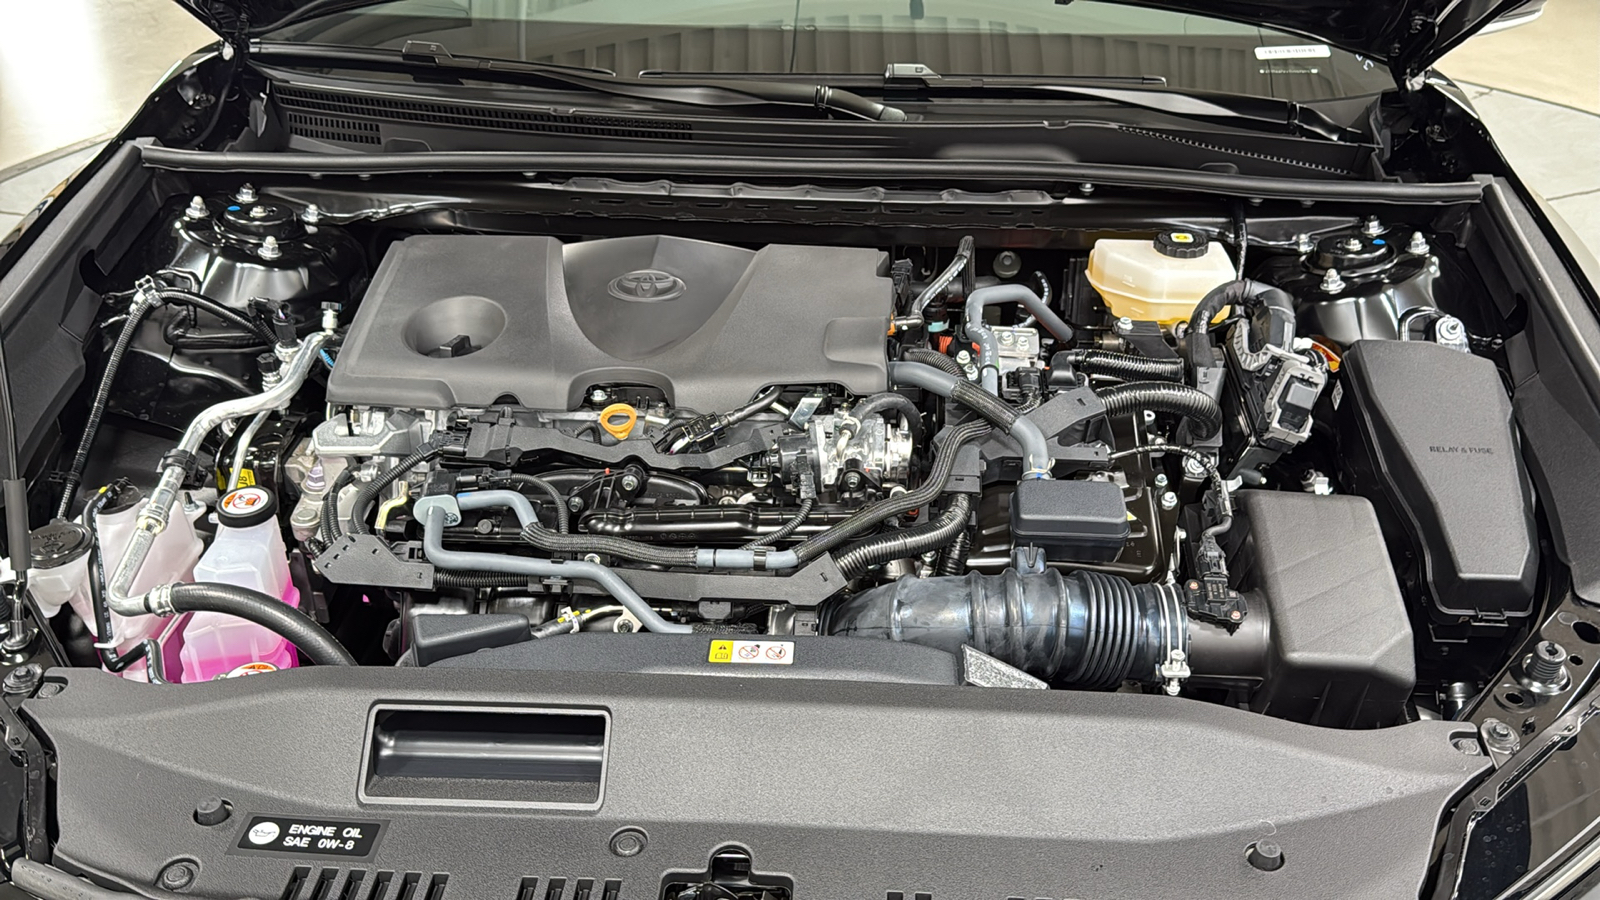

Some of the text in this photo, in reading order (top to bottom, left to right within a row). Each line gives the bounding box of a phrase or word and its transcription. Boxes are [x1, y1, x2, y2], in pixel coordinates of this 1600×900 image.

[1468, 447, 1493, 455] FUSE
[289, 824, 362, 838] ENGINE OIL
[283, 836, 355, 850] SAE 0W-8
